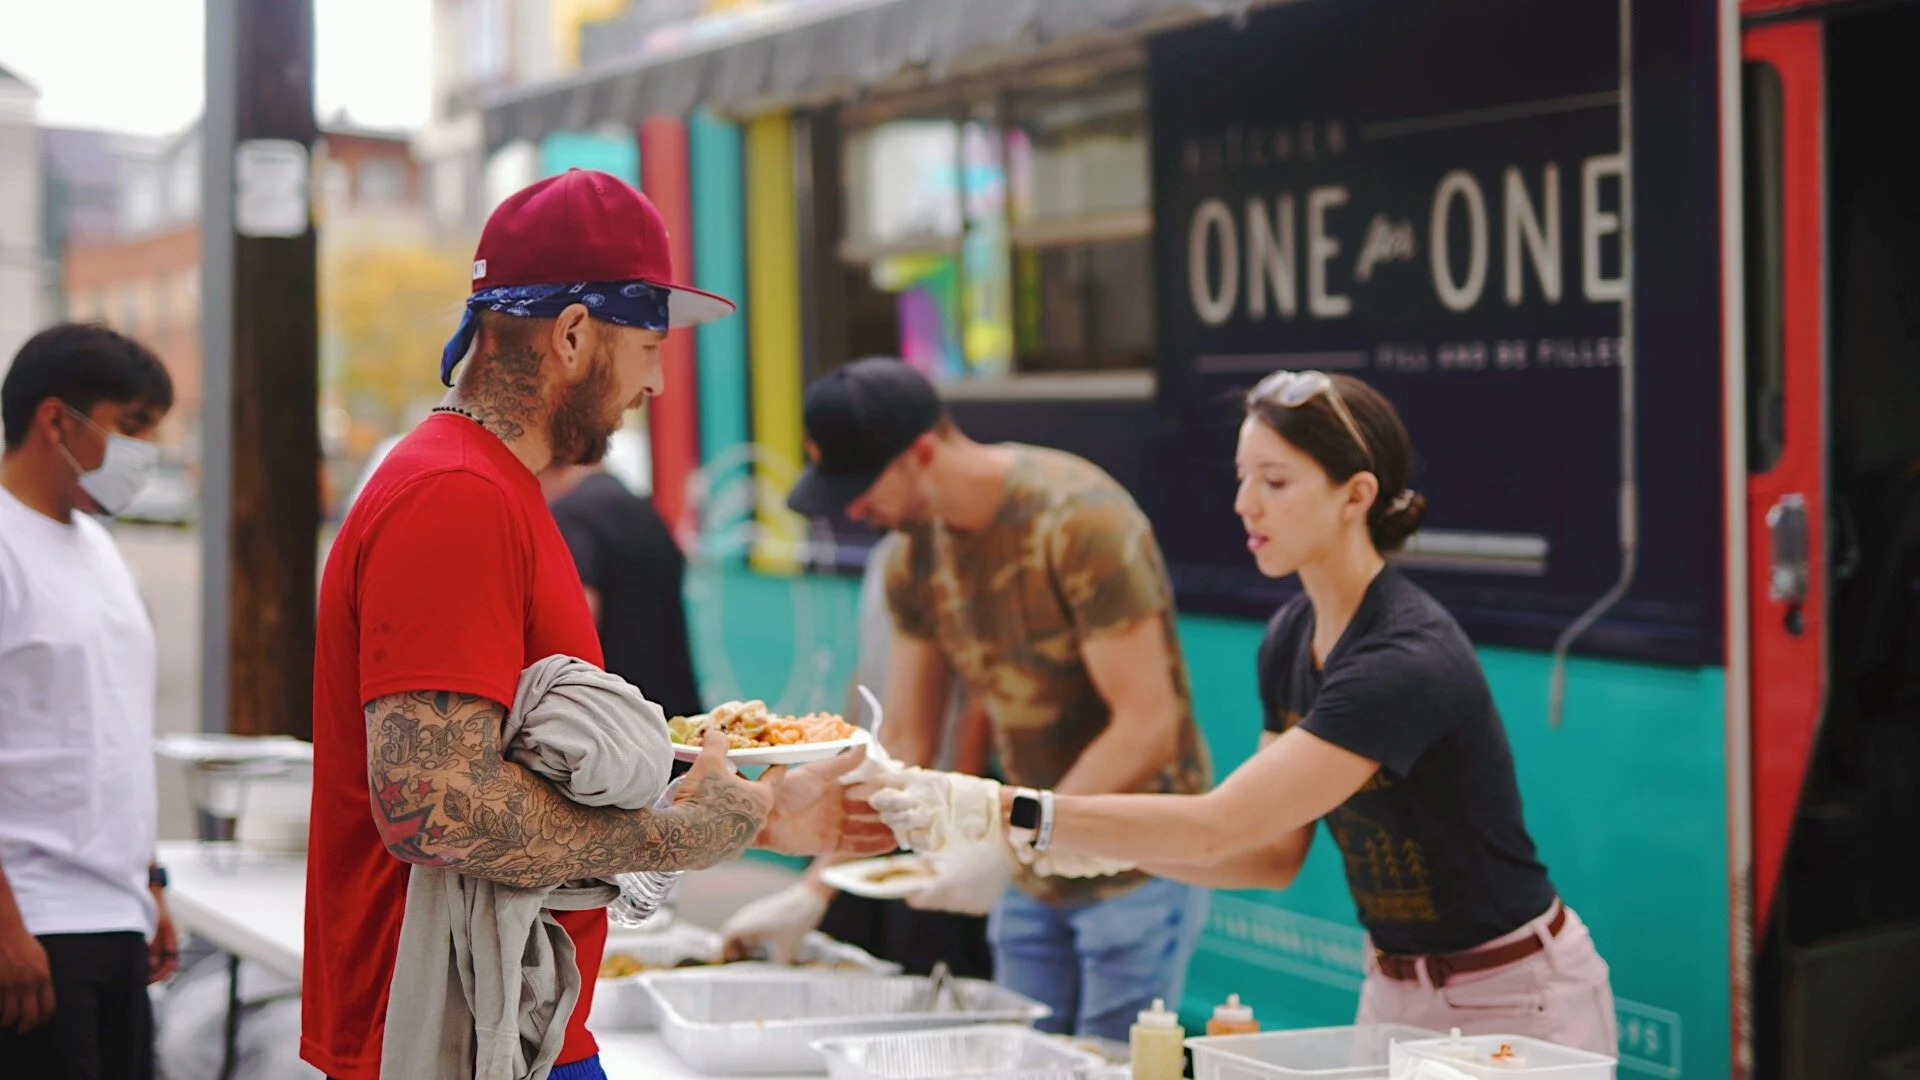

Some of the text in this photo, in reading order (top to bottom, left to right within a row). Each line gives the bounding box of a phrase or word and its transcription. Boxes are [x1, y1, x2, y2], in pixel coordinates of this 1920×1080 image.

[1188, 185, 1352, 325] ONE
[1429, 153, 1627, 312] ONE
[1377, 337, 1622, 372] FILL AND BE FILLE
